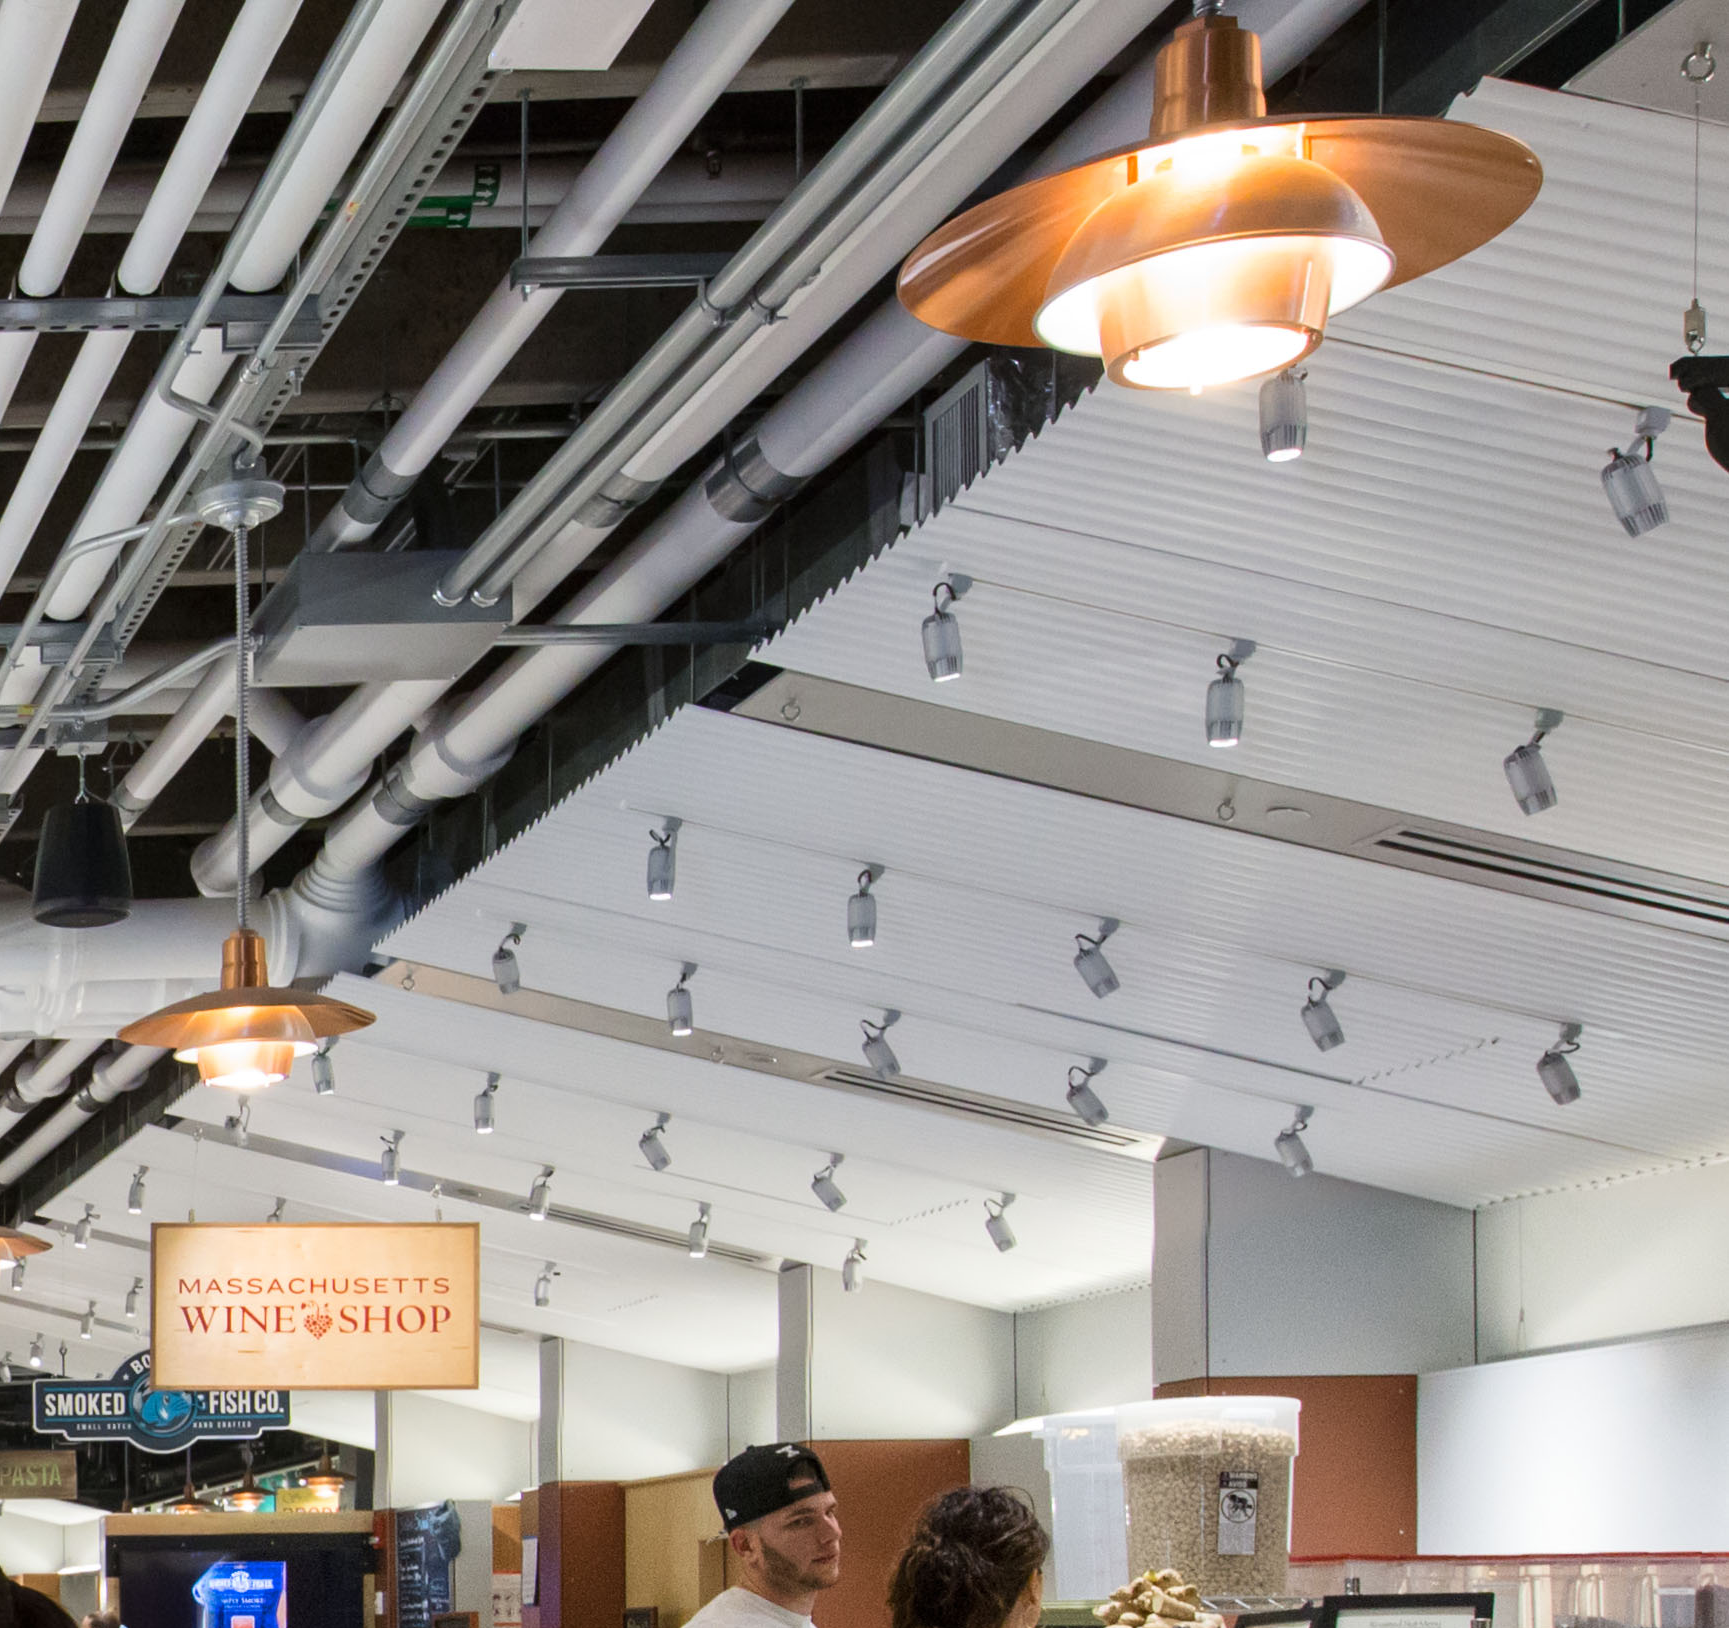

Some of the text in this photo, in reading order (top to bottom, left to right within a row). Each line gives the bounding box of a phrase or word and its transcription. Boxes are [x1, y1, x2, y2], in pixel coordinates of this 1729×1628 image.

[179, 1278, 451, 1294] MASSACHUSETTS
[180, 1304, 452, 1334] WINE SHOP
[44, 1389, 284, 1416] SMOKED FISH CO.
